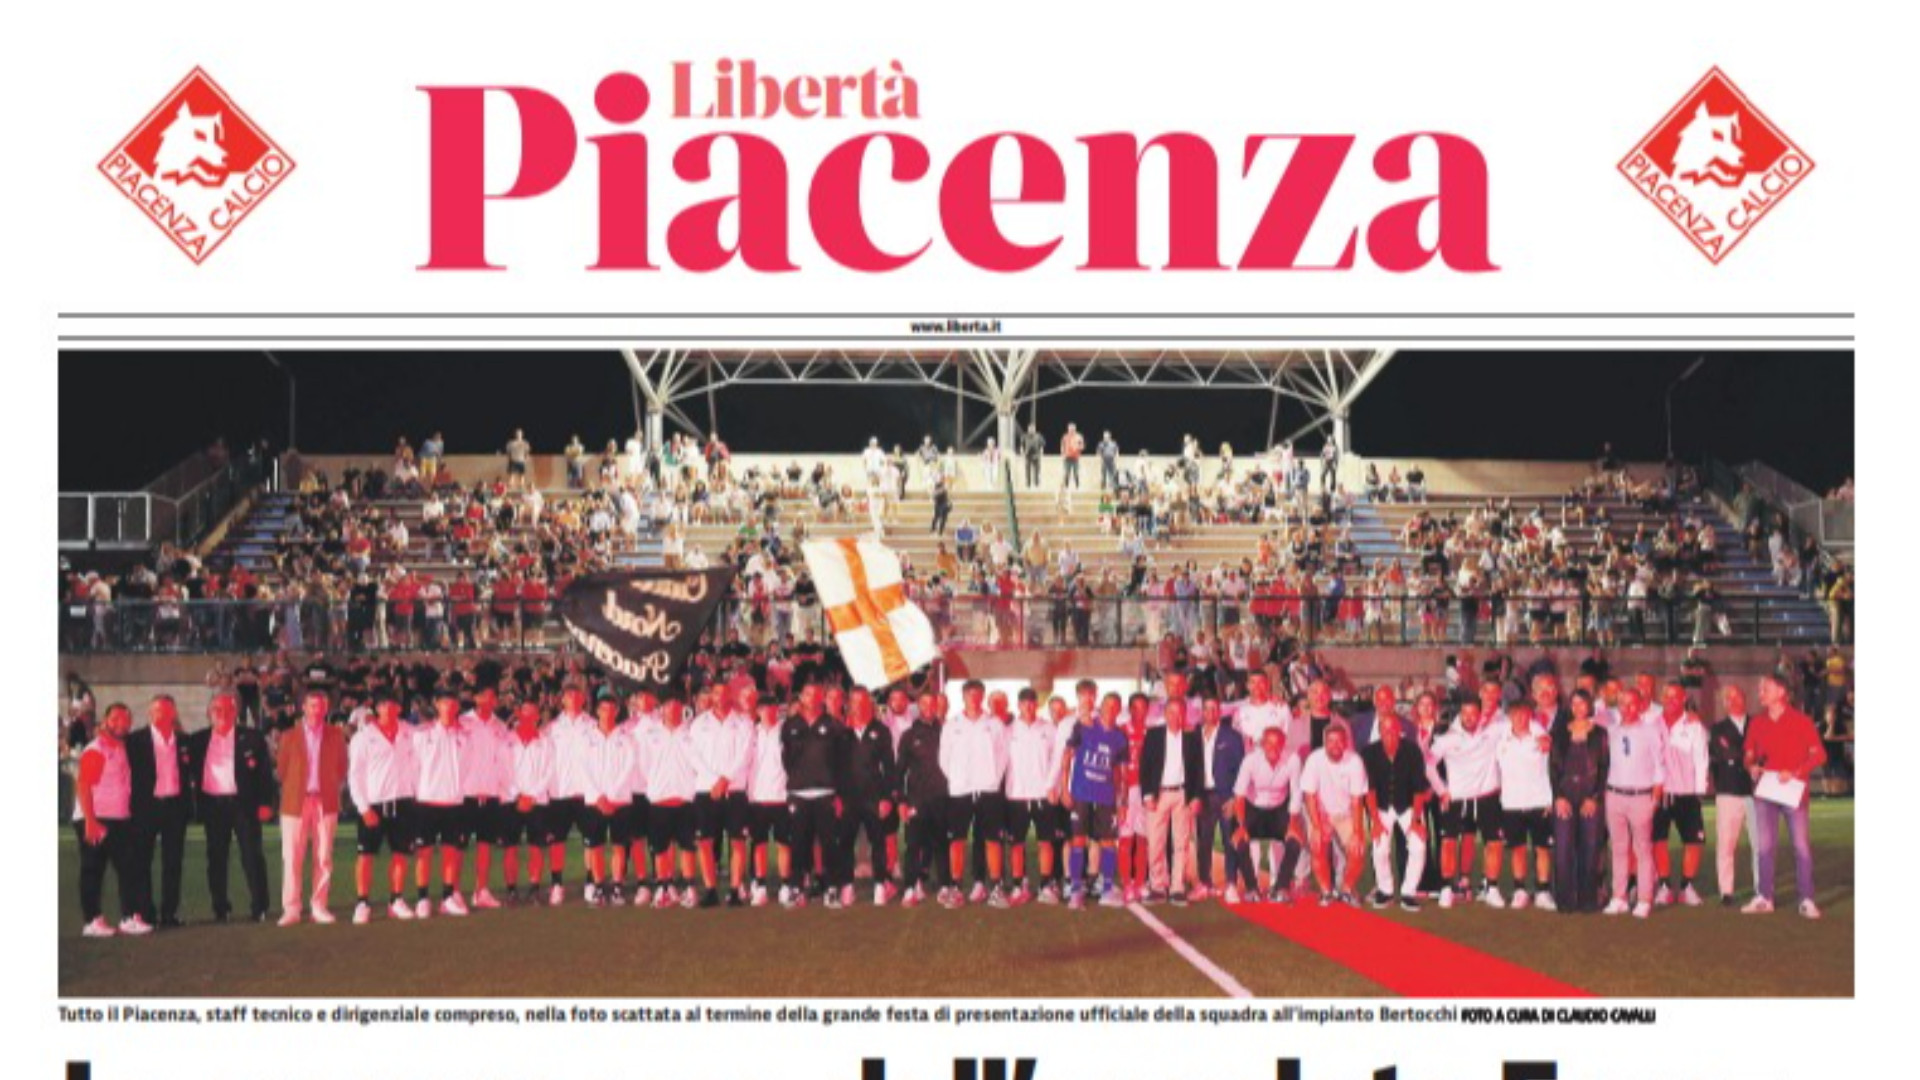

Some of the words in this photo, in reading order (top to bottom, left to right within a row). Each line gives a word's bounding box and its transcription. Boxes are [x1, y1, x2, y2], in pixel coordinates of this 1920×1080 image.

[673, 58, 919, 119] Libertà
[106, 153, 207, 256] PIACENZA
[209, 154, 284, 230] CALCIO
[417, 72, 1501, 273] Piacenza
[1626, 153, 1725, 256] PIACENZA
[1726, 154, 1803, 230] CALCIO
[60, 1007, 103, 1021] Tutto
[107, 1007, 119, 1021] il
[123, 1007, 200, 1024] Piacenza,
[206, 1007, 247, 1021] staff
[252, 1007, 313, 1021] tecnico
[317, 1010, 326, 1021] e
[332, 1007, 430, 1024] dirigenziale
[434, 1010, 519, 1024] compreso,
[526, 1007, 566, 1021] nella
[571, 1007, 608, 1021] foto
[613, 1007, 681, 1021] scattata
[686, 1007, 701, 1021] al
[705, 1007, 772, 1021] termine
[776, 1007, 818, 1021] della
[822, 1007, 881, 1024] grande
[886, 1007, 929, 1021] festa
[934, 1007, 951, 1021] di
[955, 1007, 1075, 1024] presentazione
[1080, 1007, 1149, 1021] ufficiale
[1154, 1007, 1195, 1021] della
[1200, 1007, 1268, 1024] squadra
[1380, 1007, 1457, 1021] Bertocchi
[1461, 1008, 1493, 1023] FOTO
[1494, 1008, 1505, 1023] A
[1506, 1008, 1540, 1023] CURA
[1541, 1008, 1555, 1023] DI
[1556, 1008, 1609, 1023] CLAUDIO
